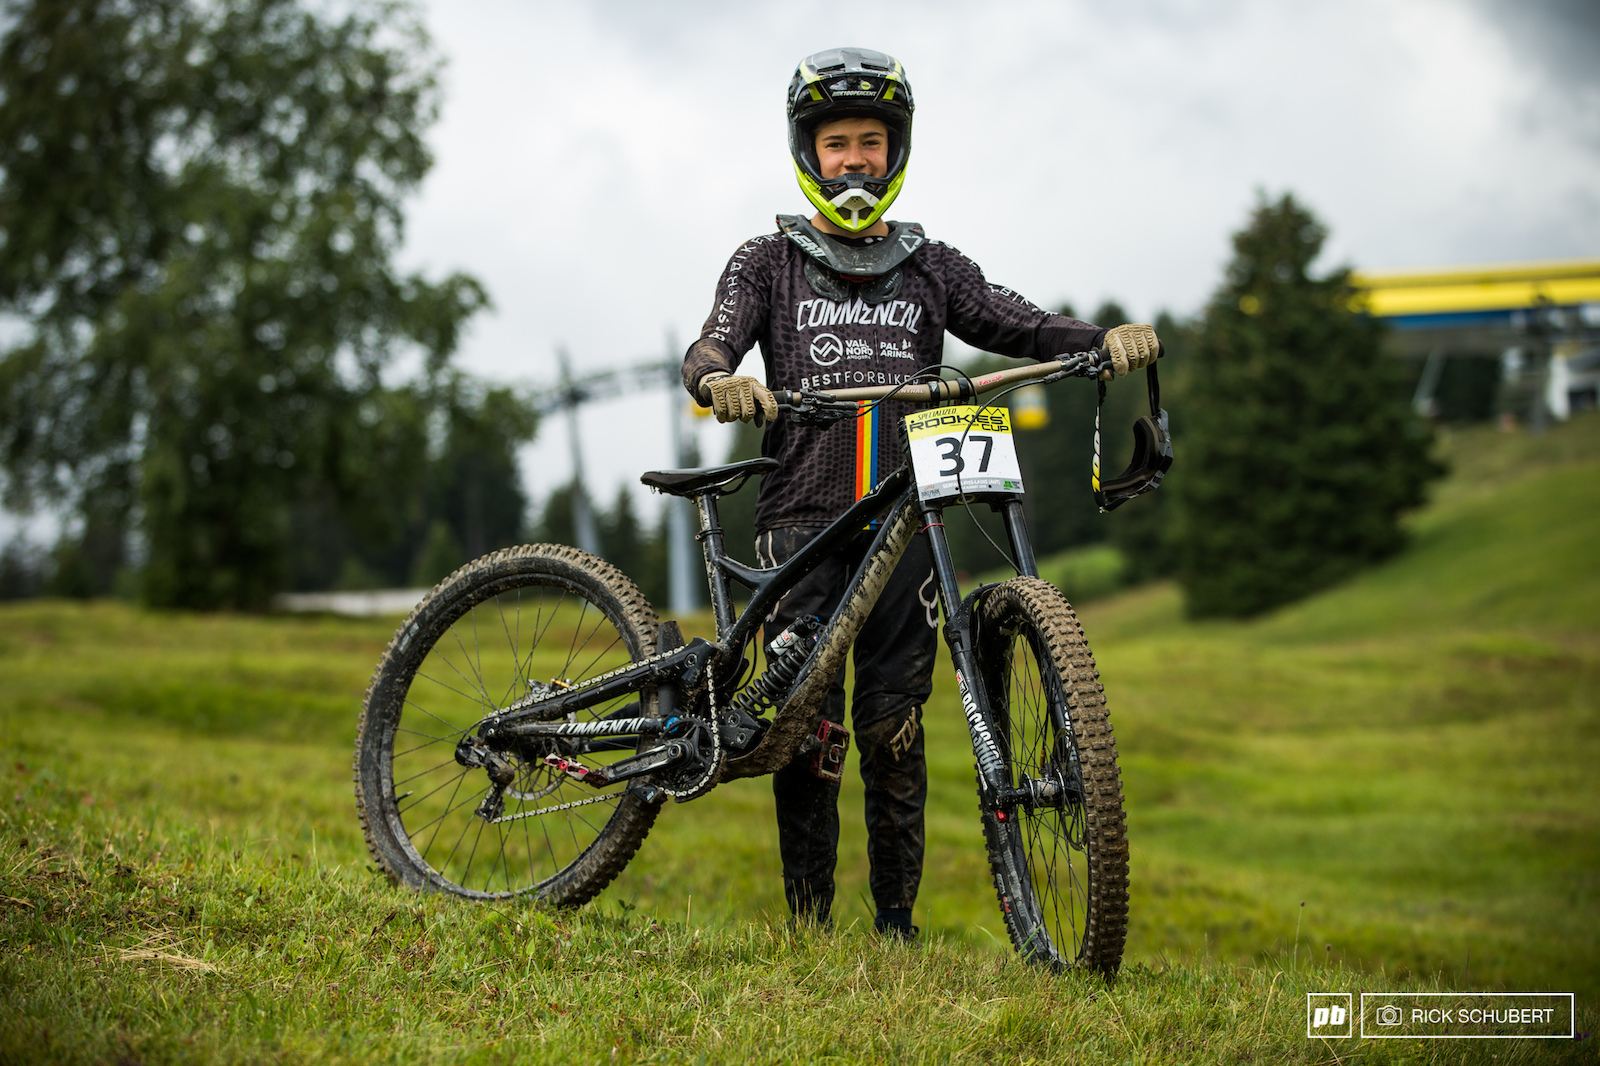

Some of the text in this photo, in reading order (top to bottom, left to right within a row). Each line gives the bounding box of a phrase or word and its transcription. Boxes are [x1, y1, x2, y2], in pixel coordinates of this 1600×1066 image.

[796, 297, 922, 335] COMMENCAL
[845, 339, 869, 348] VALL
[880, 341, 899, 351] PAL
[845, 346, 874, 356] NORD
[880, 349, 915, 361] ARINSAL
[917, 407, 957, 421] SPECIALIZED
[909, 414, 1004, 432] ROOKIES
[981, 424, 1010, 432] CUP
[935, 435, 994, 477] 37
[889, 706, 919, 762] FOX
